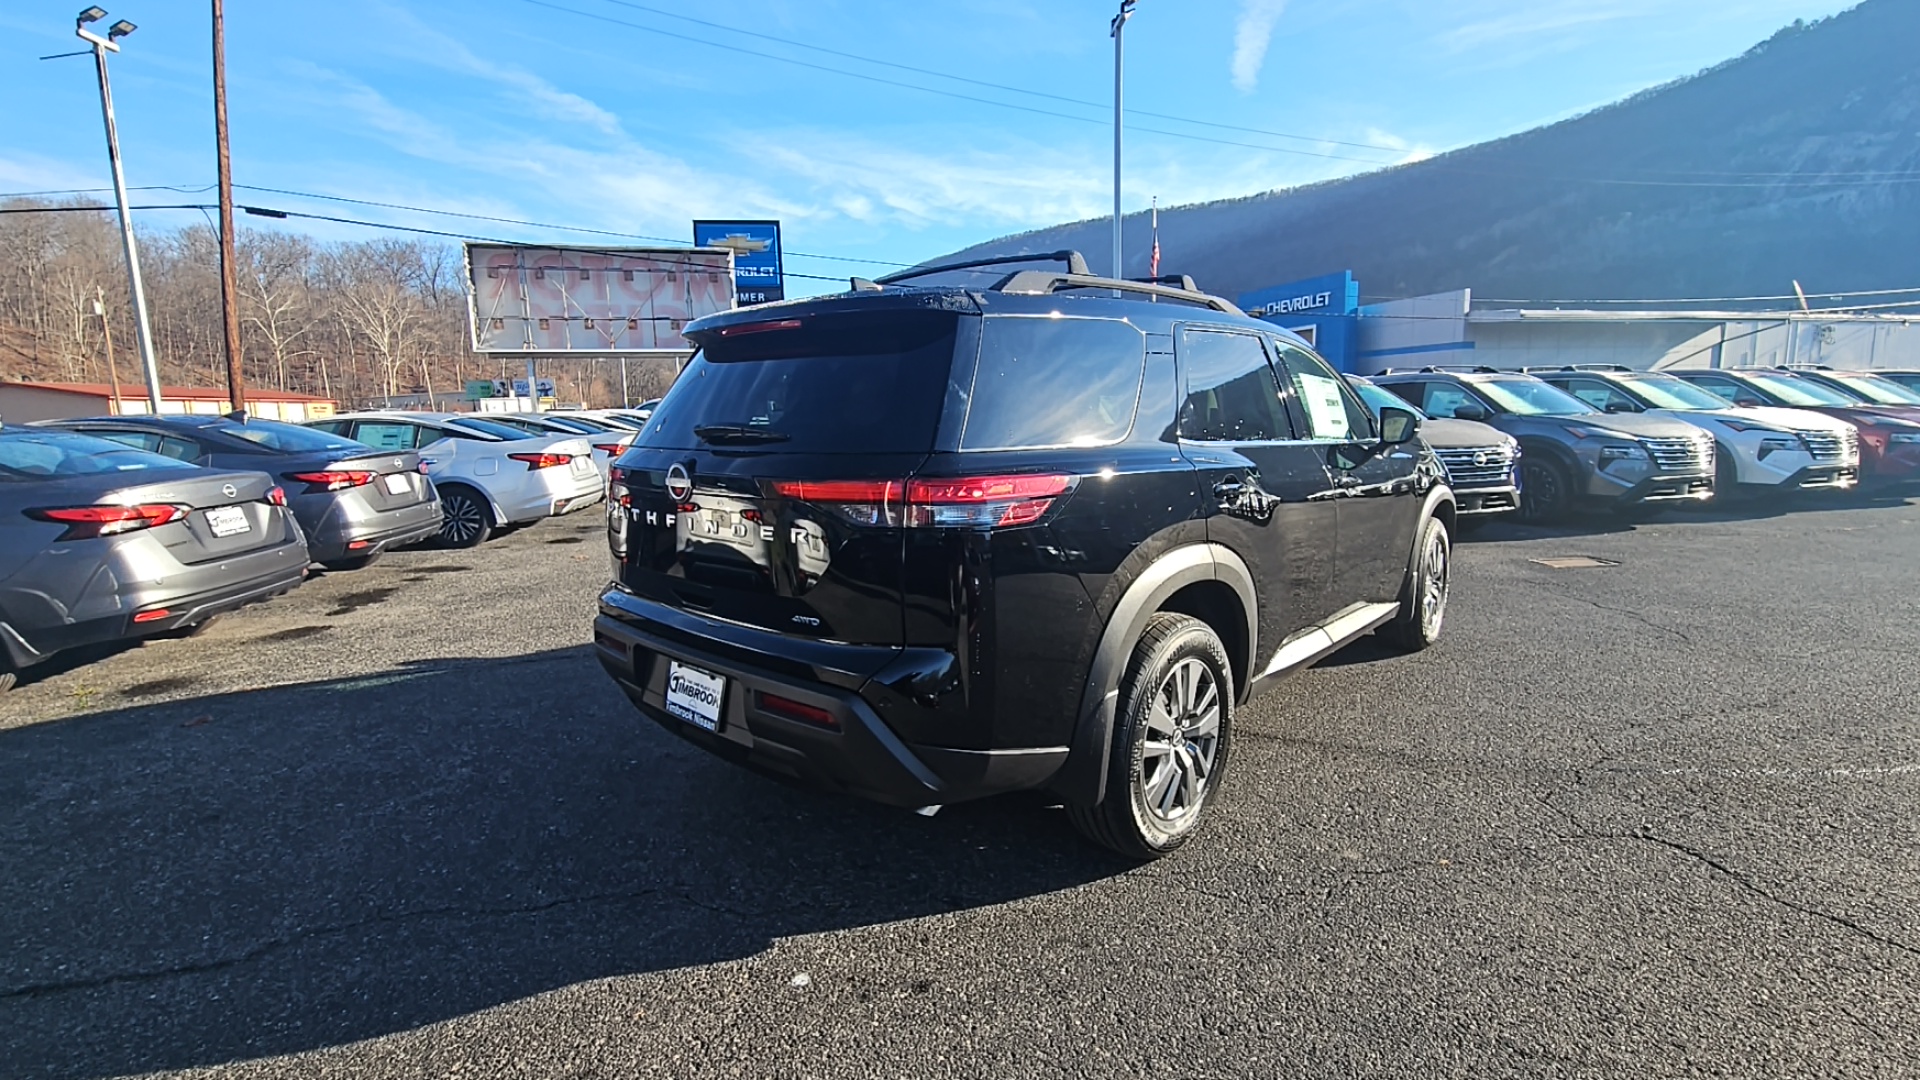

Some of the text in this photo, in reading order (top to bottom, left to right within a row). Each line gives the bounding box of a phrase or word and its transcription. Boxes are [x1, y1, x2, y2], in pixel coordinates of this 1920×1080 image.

[735, 266, 775, 277] ROLET
[1266, 291, 1332, 316] CHEVROLET
[607, 499, 811, 545] PATHFINDER
